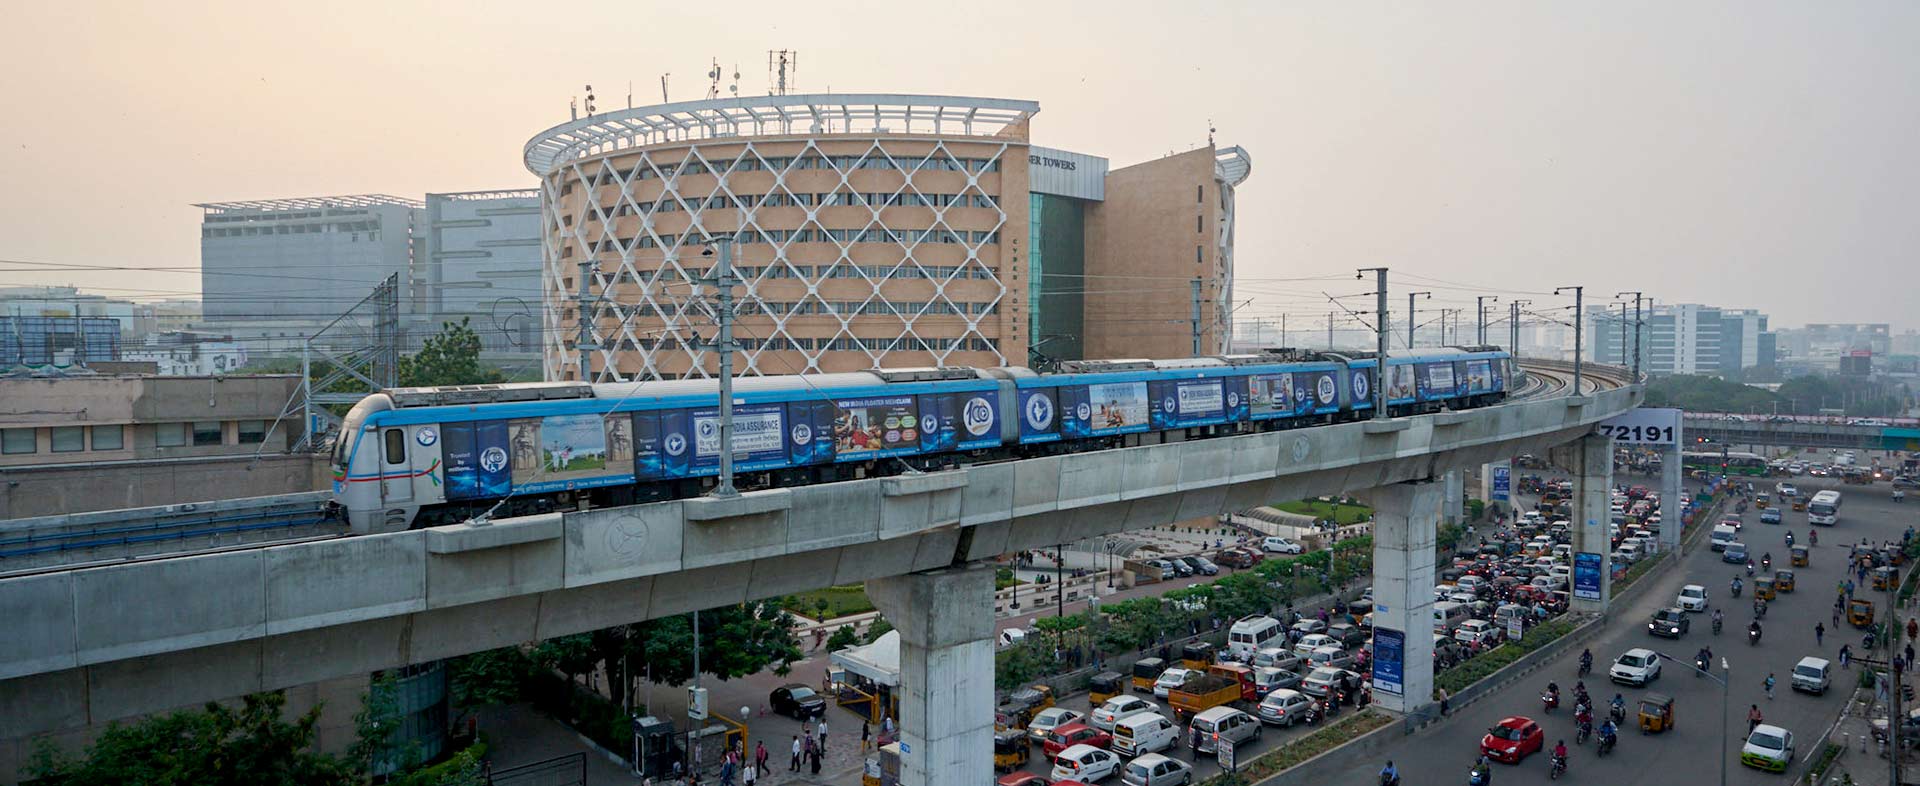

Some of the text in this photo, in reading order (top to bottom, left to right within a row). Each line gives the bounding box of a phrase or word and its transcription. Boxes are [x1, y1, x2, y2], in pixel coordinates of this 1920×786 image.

[1029, 155, 1076, 171] ER TOWERS
[734, 421, 746, 432] NDIA
[746, 420, 779, 431] ASSURANCE
[1601, 425, 1672, 442] 72191
